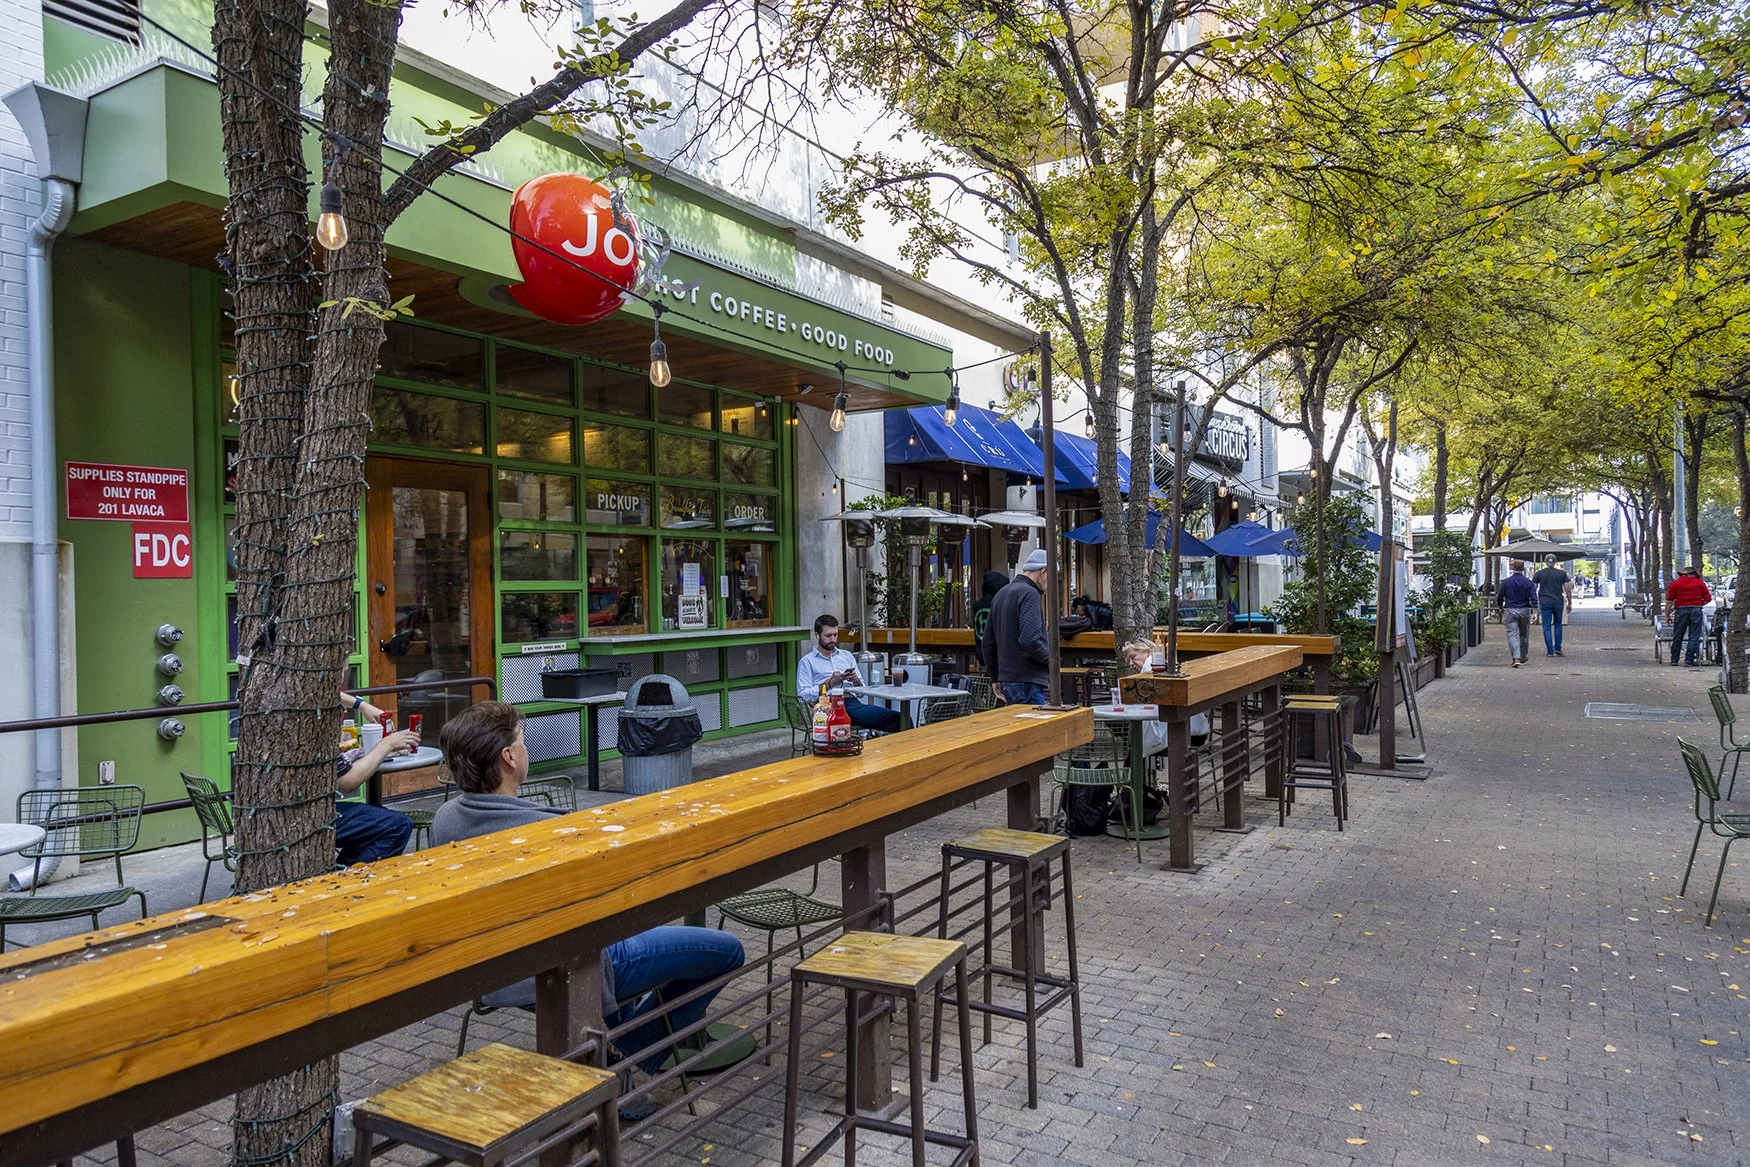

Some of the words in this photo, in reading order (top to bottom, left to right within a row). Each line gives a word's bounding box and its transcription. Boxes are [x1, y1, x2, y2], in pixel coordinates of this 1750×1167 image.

[709, 291, 787, 333] COFFEE
[800, 322, 848, 351] GOOD
[854, 339, 895, 366] FOOD
[1212, 428, 1248, 460] CIRCUS
[69, 467, 124, 482] SUPPLIES
[127, 471, 186, 486] STANDPIPE
[103, 486, 131, 499] ONLY
[134, 488, 156, 500] FOR
[597, 493, 639, 511] PICKUP
[98, 502, 118, 514] 201
[121, 504, 165, 516] LAVACA
[734, 505, 765, 520] ORDER
[134, 533, 190, 568] FDC
